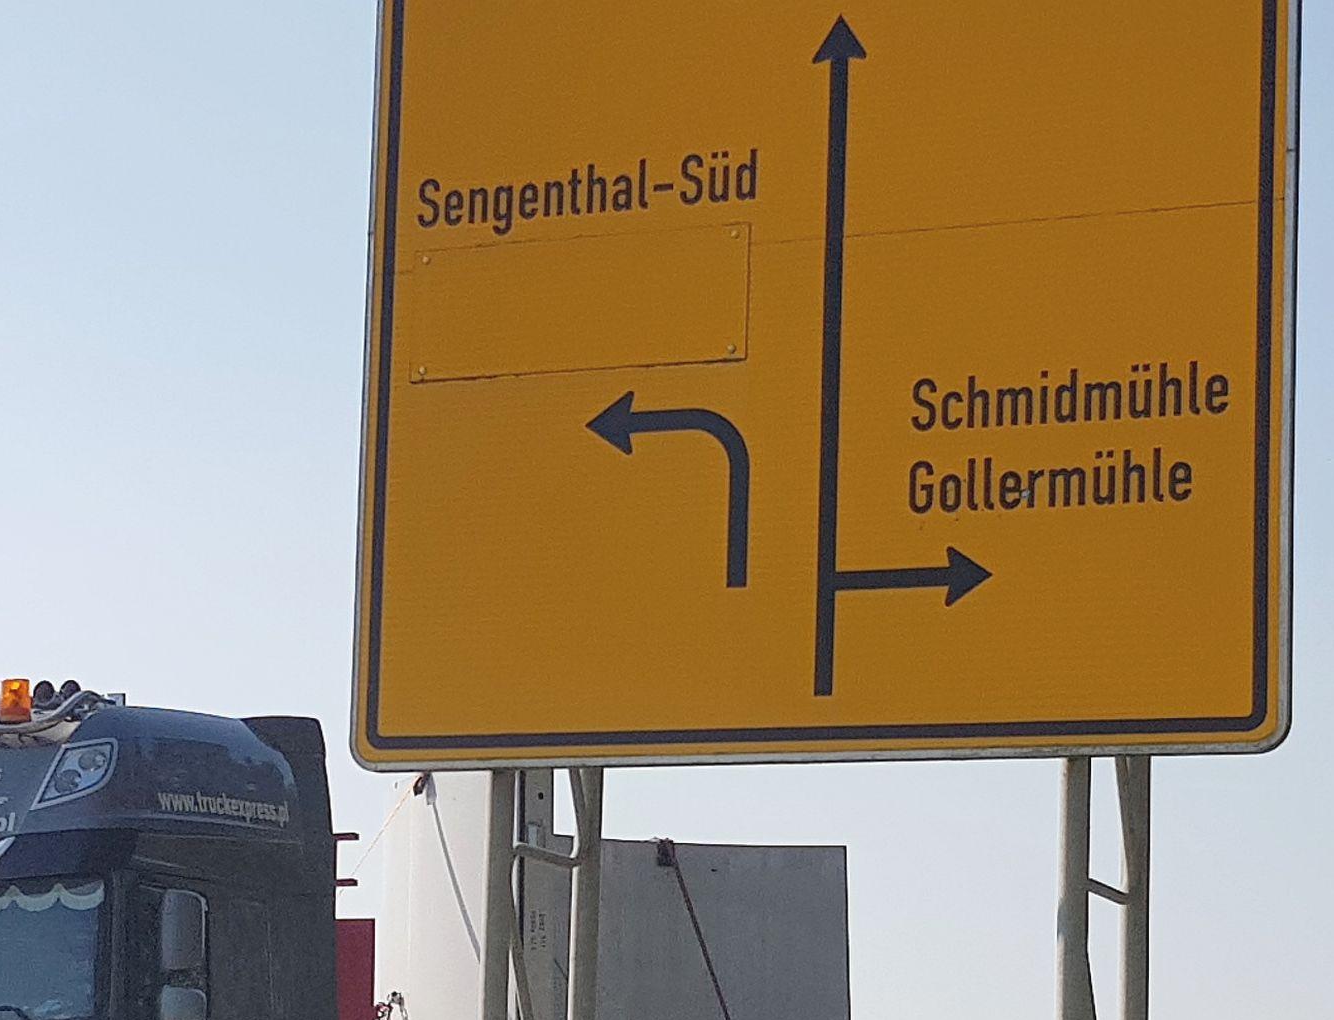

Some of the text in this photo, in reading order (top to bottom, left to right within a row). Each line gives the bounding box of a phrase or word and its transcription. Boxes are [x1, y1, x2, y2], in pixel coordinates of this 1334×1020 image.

[417, 148, 759, 236] Sengenthal-Süd
[910, 360, 1229, 432] Schmidmühle
[908, 446, 1193, 514] Gollermühle
[157, 790, 289, 828] www.truckexpress.pl
